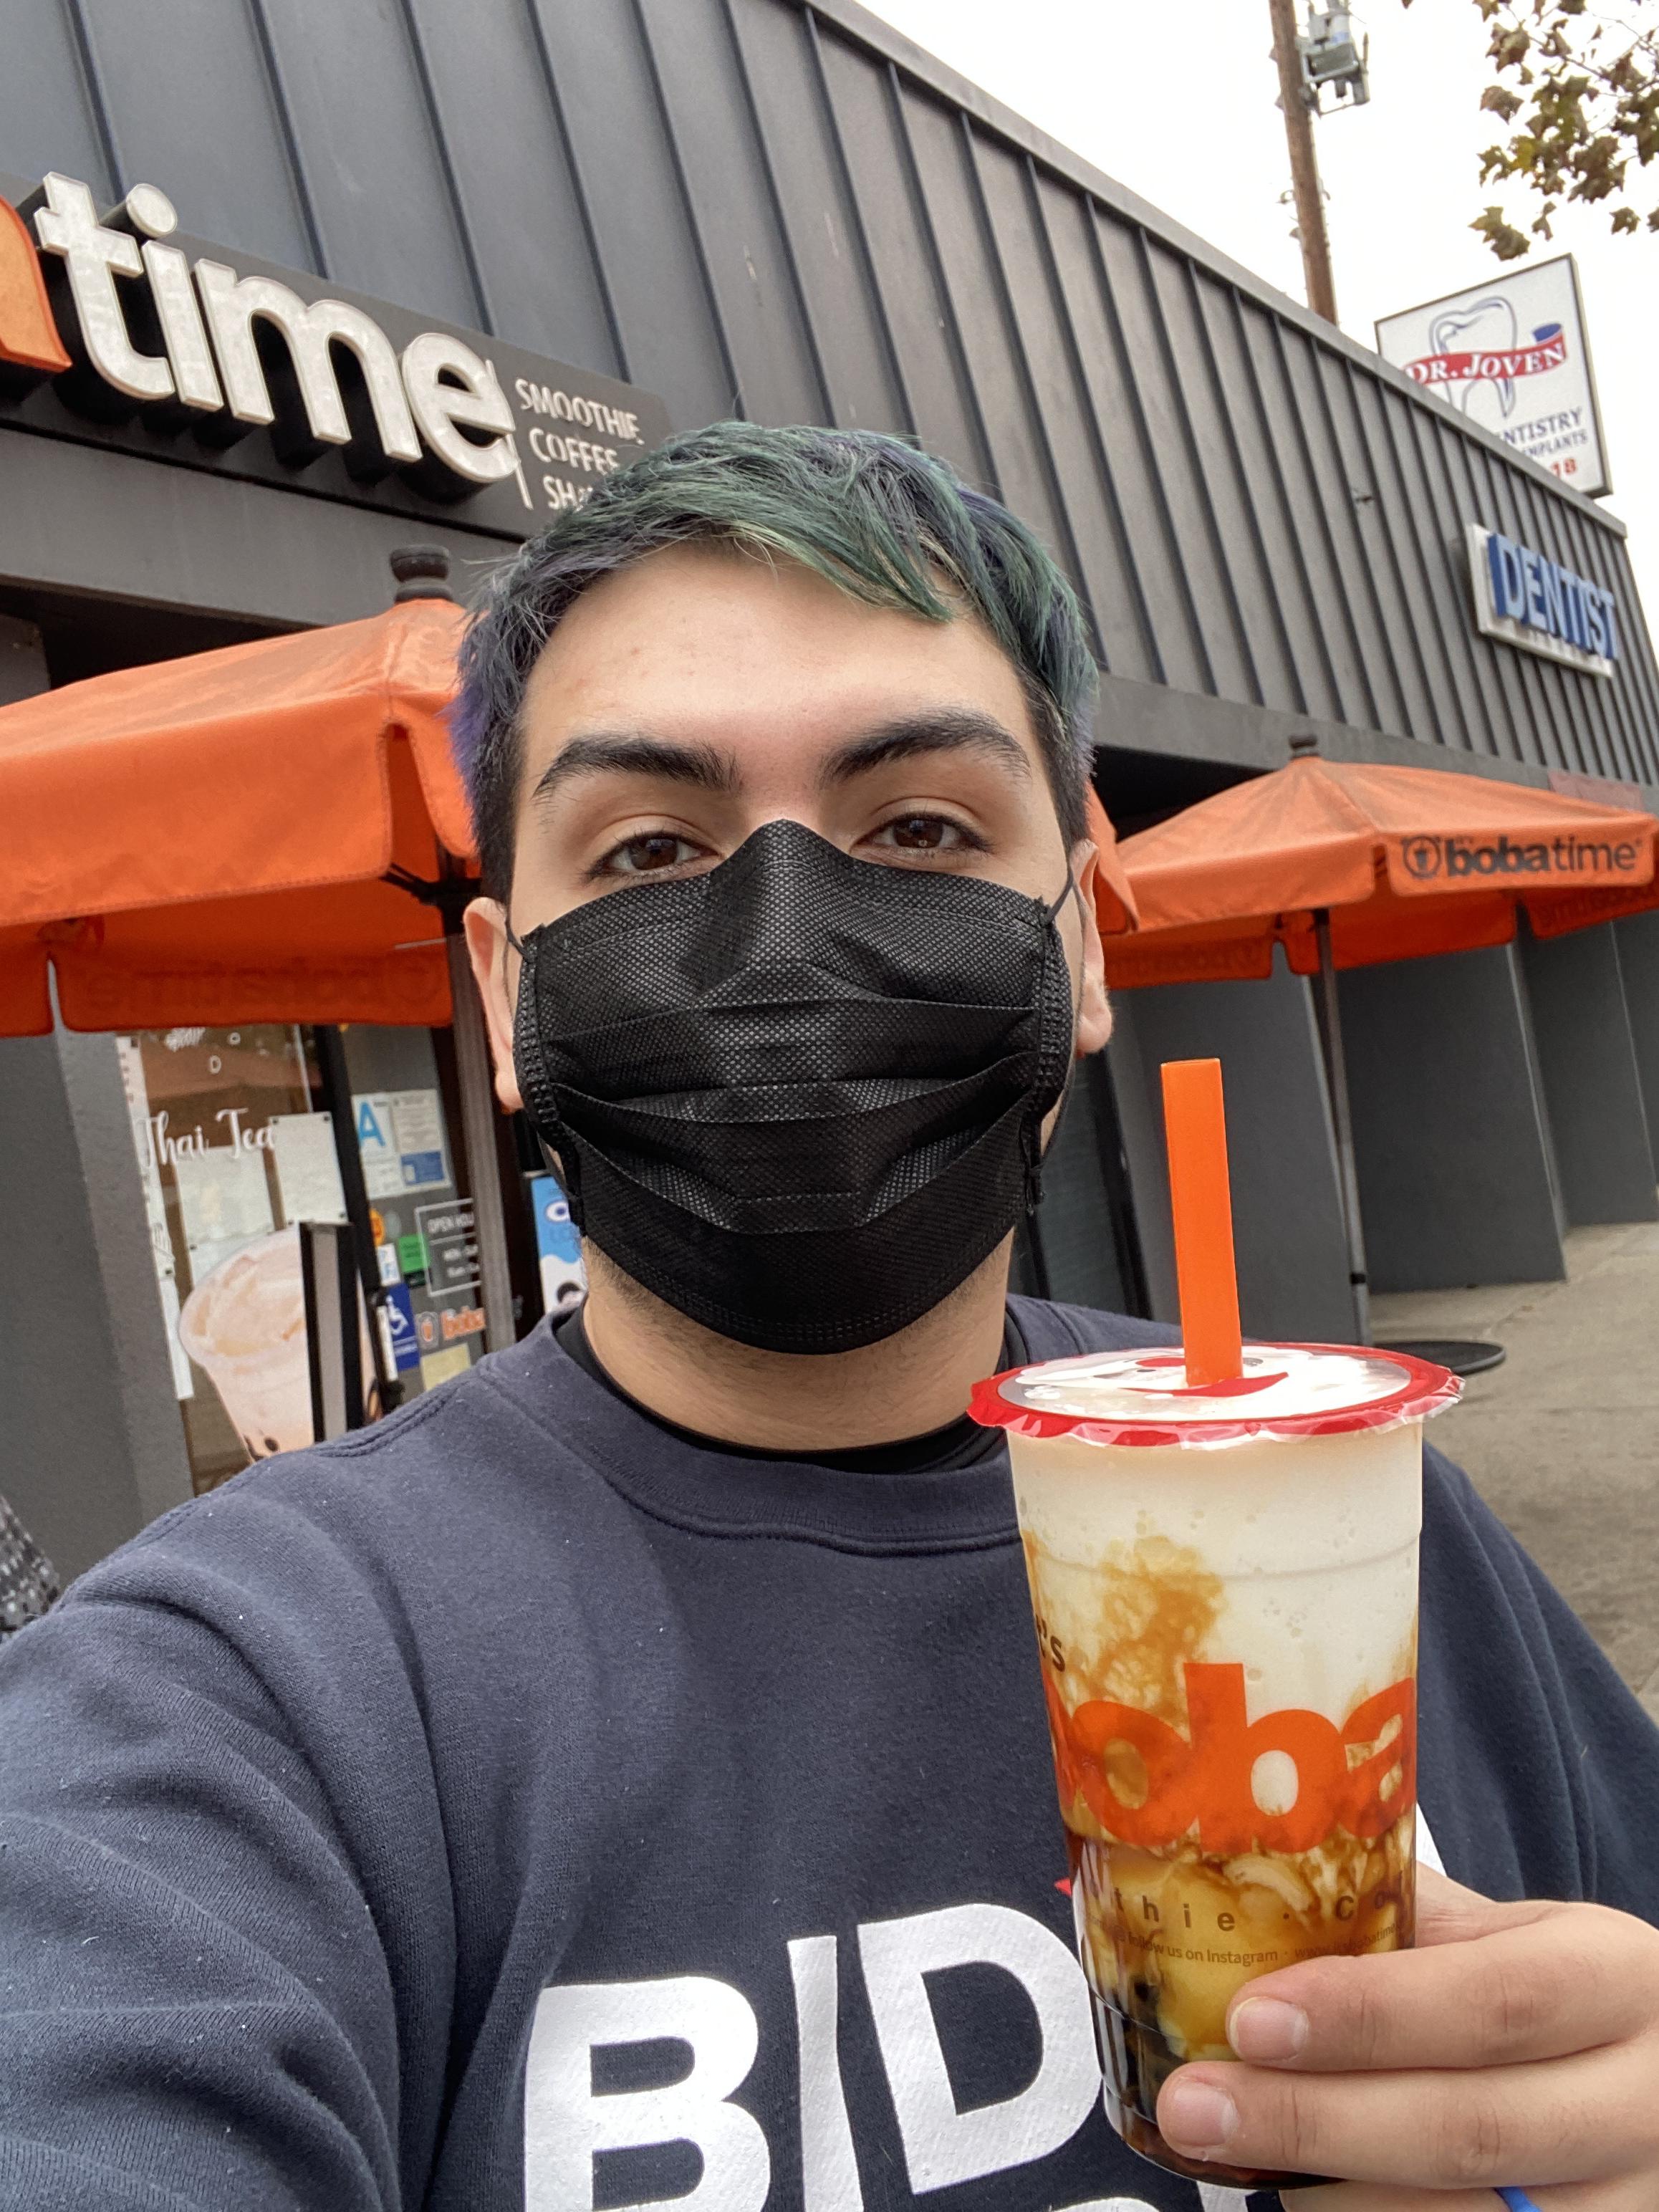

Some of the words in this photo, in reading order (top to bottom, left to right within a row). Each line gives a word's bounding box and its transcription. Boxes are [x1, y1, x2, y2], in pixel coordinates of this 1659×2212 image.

[34, 171, 519, 484] time
[1405, 359, 1458, 383] DR.
[1462, 342, 1564, 379] JOVEN
[514, 378, 643, 444] SMOOTHIE
[1503, 406, 1583, 444] NTISTRY
[528, 427, 620, 476] COFFEE
[1488, 533, 1619, 660] DENTIST
[1445, 835, 1636, 877] bobatime
[216, 1107, 275, 1159] Tea
[357, 1101, 386, 1148] A
[1167, 1943, 1183, 1958] us
[1186, 1948, 1204, 1961] on
[1207, 1948, 1279, 1968] Instagram
